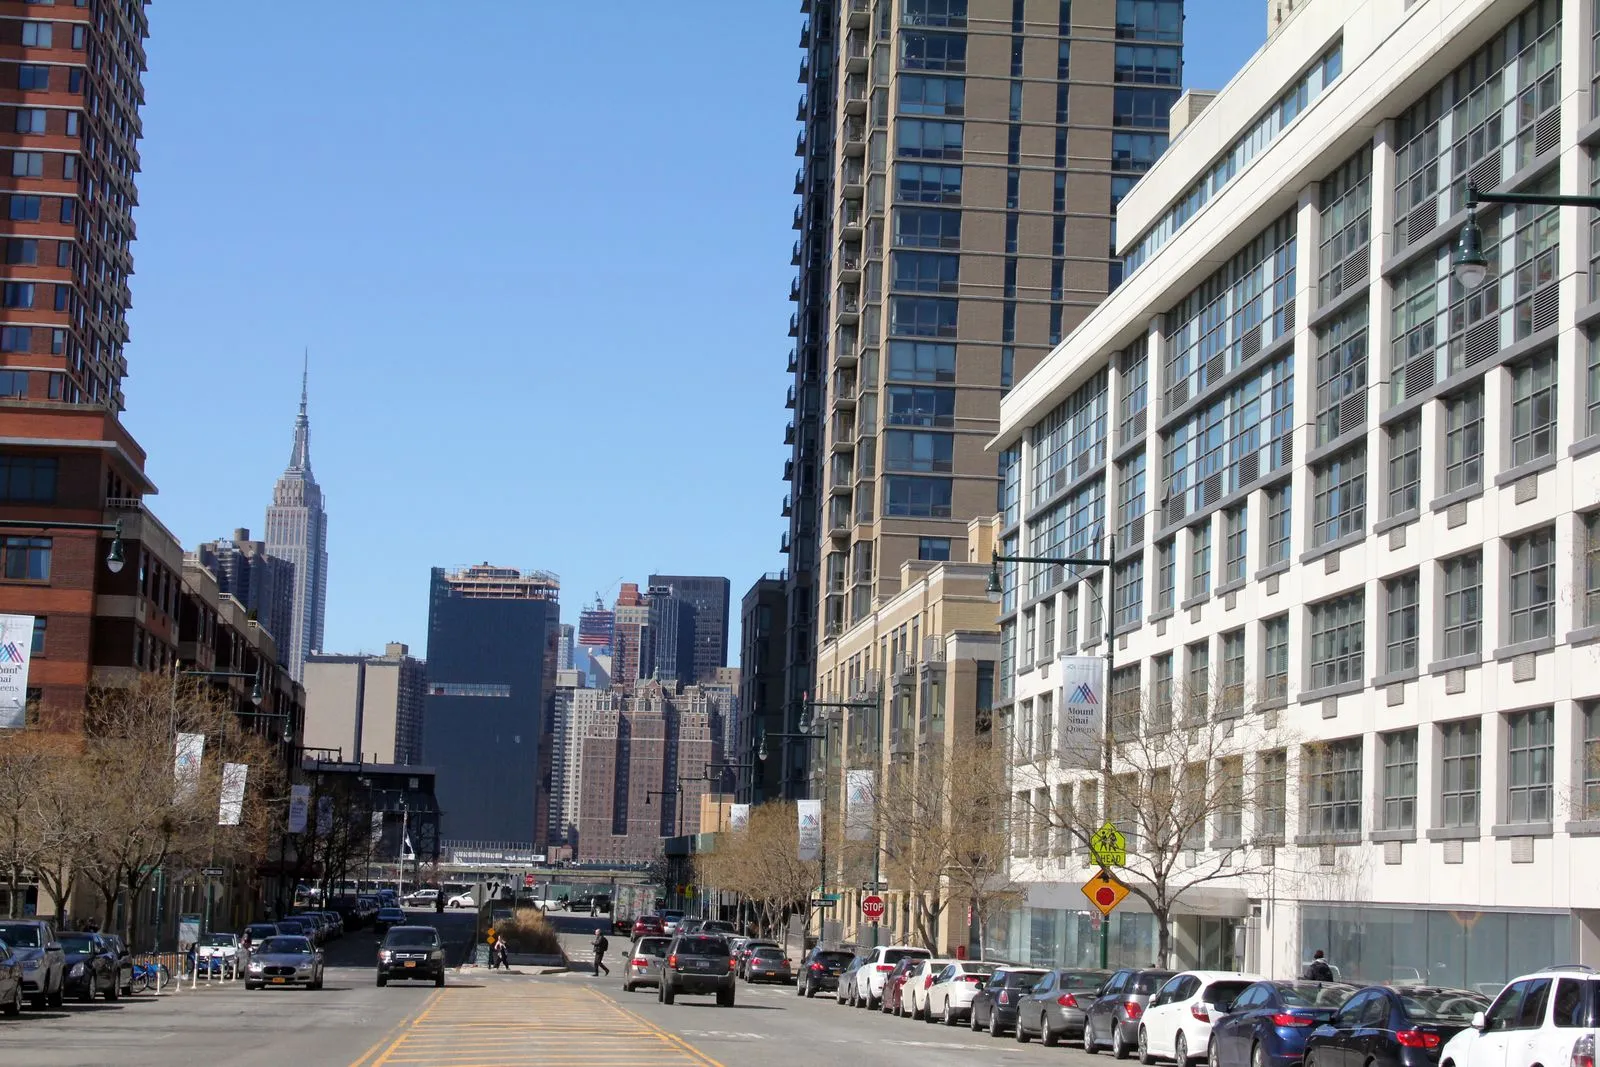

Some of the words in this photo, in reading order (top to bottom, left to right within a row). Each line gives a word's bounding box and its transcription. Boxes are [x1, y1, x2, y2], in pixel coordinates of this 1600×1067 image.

[1067, 707, 1094, 716] Mount
[1067, 716, 1089, 725] Sinai
[1092, 854, 1121, 864] HEAD
[863, 902, 884, 912] STOP
